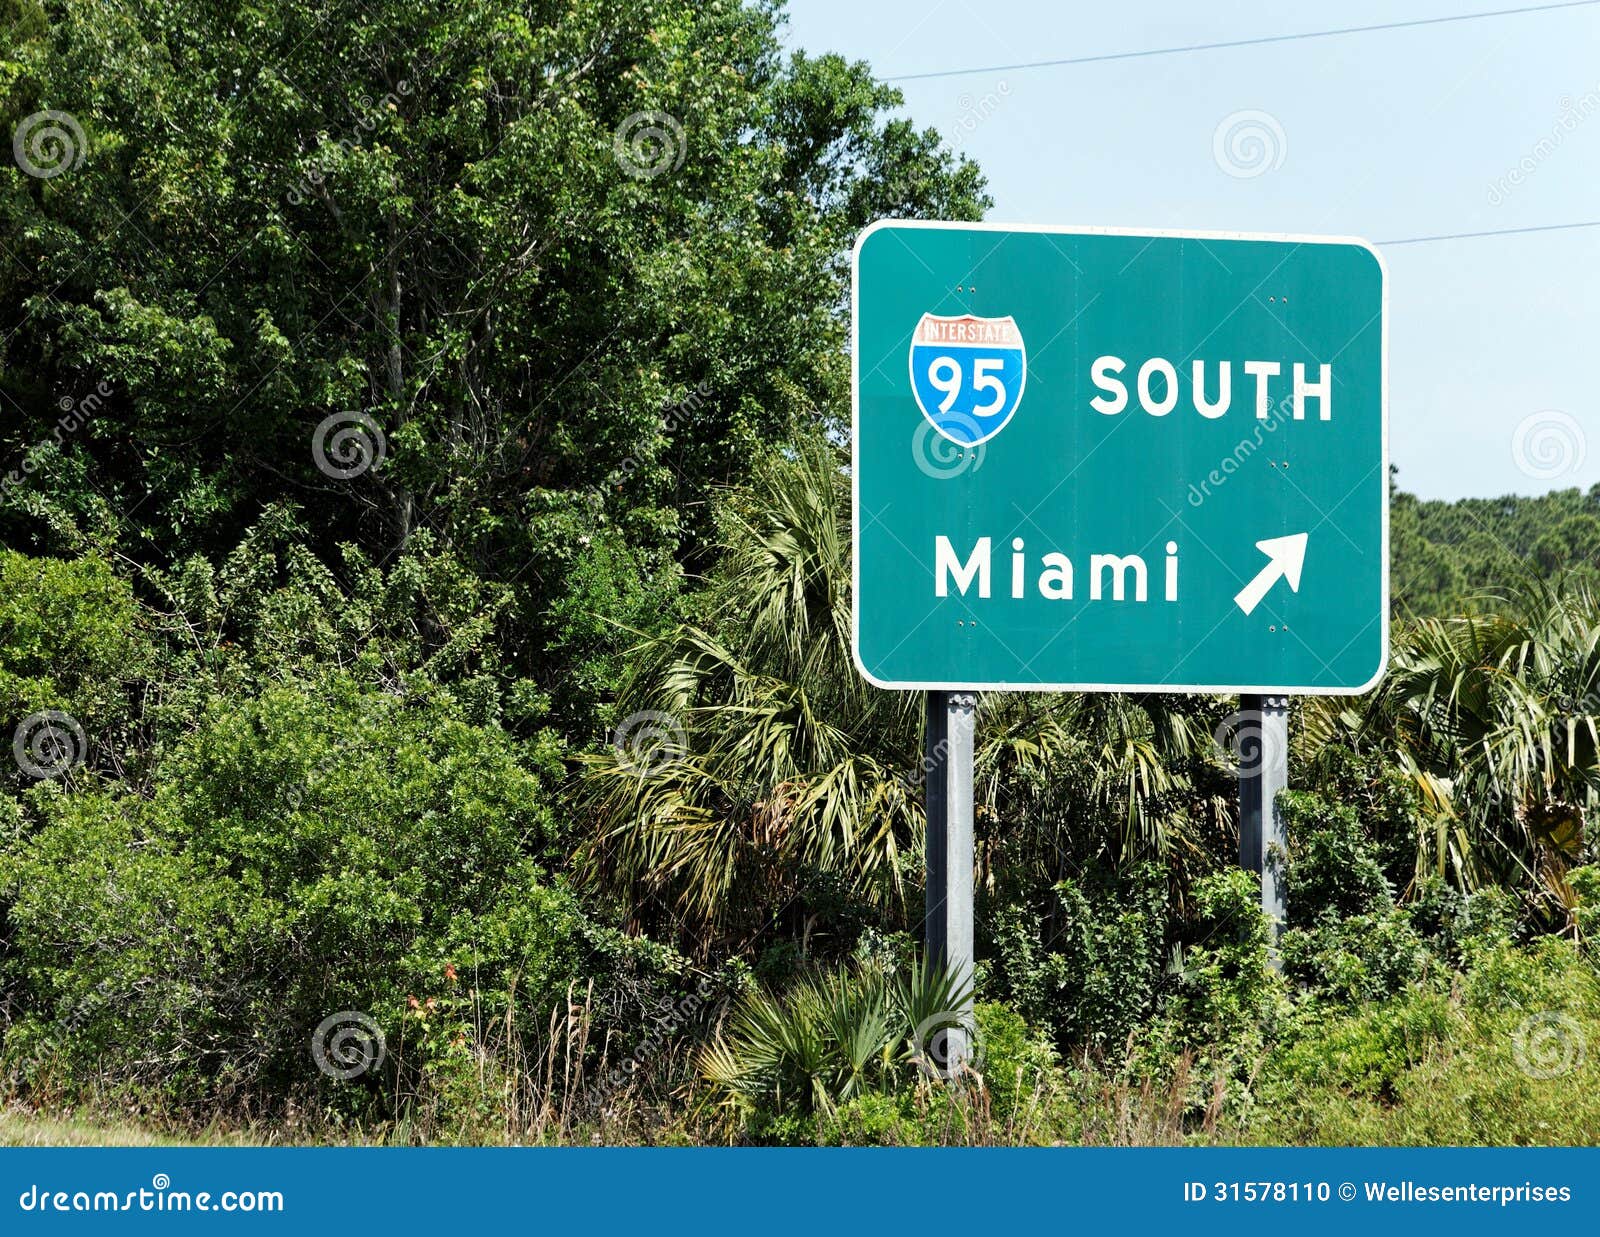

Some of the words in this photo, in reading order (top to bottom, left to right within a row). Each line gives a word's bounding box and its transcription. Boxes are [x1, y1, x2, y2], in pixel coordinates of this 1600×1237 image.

[924, 321, 1011, 342] INTERSTATE
[928, 356, 1006, 417] 95
[1089, 355, 1332, 420] SOUTH
[935, 535, 1178, 601] Miami
